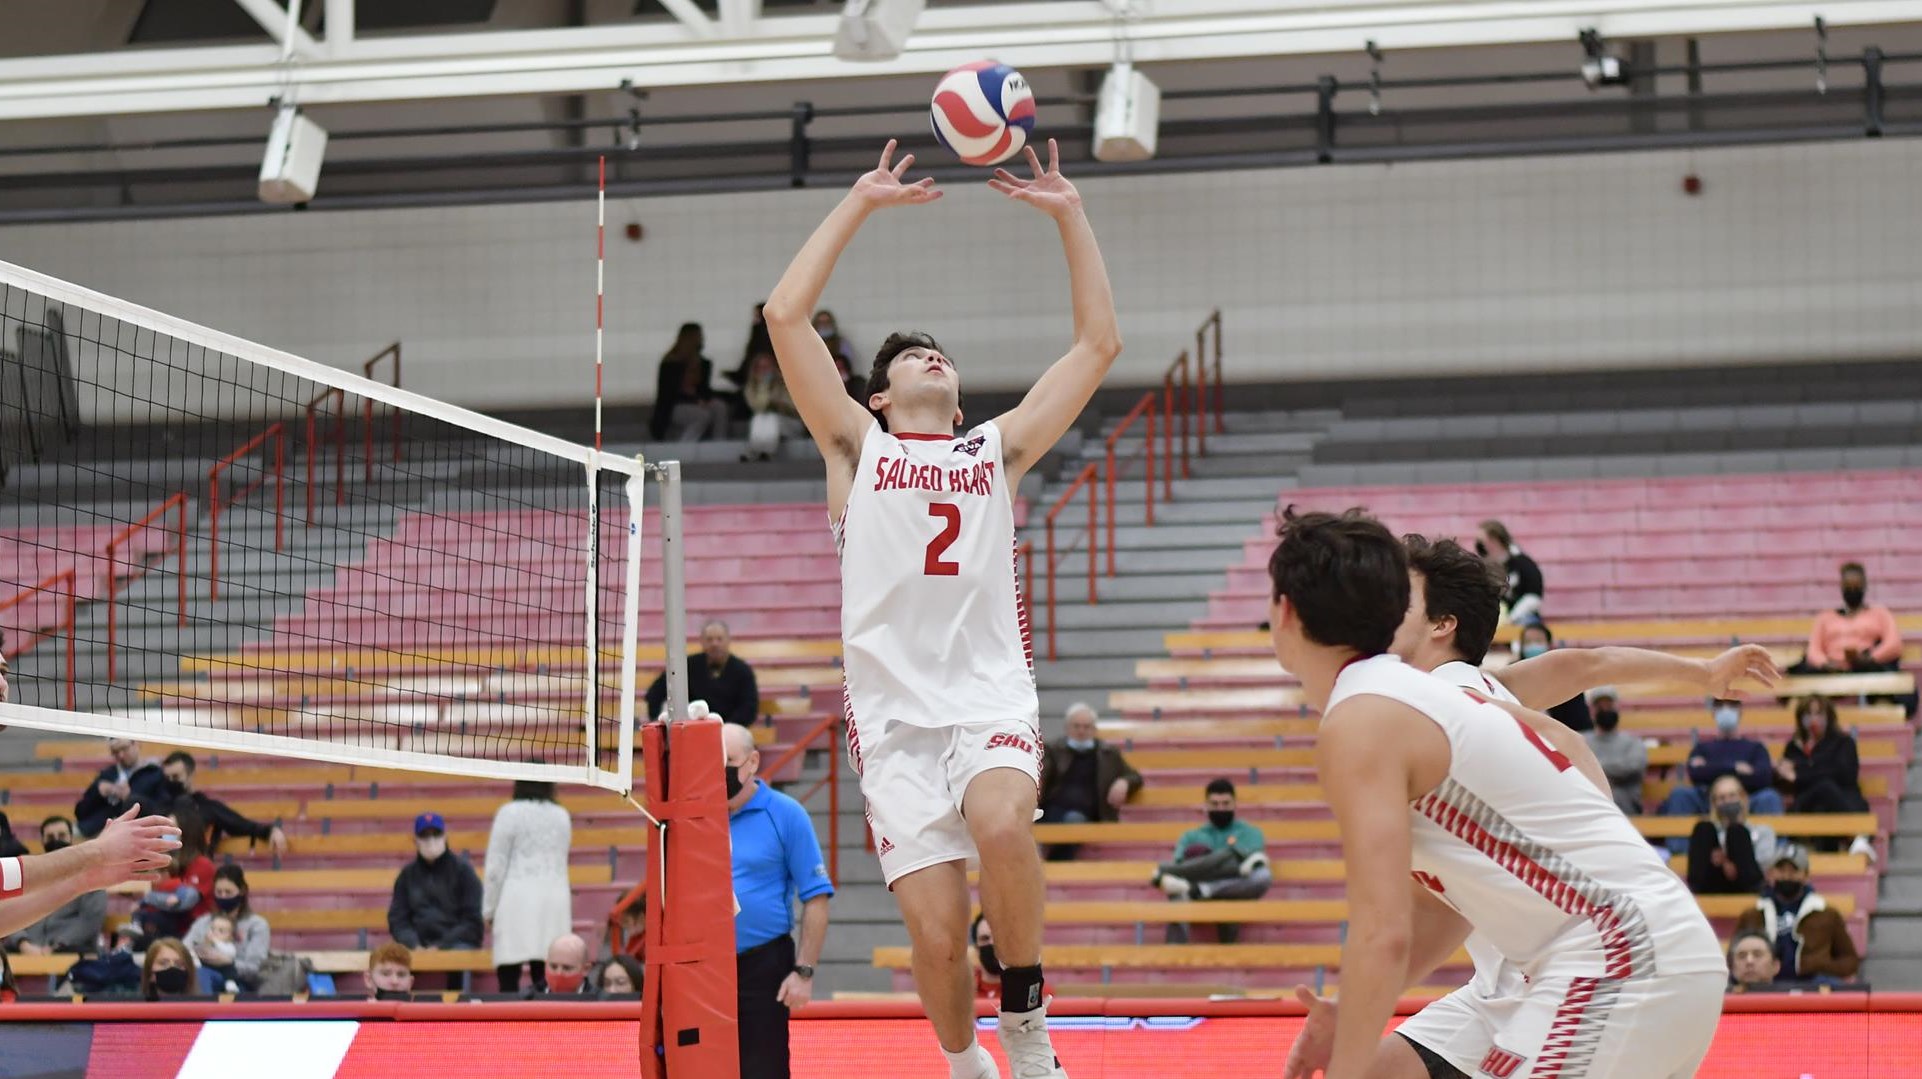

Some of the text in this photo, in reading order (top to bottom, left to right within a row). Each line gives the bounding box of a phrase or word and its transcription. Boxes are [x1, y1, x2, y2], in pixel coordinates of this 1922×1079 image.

[924, 502, 962, 576] 2
[984, 732, 1033, 753] SHU
[1479, 1046, 1526, 1079] HU
